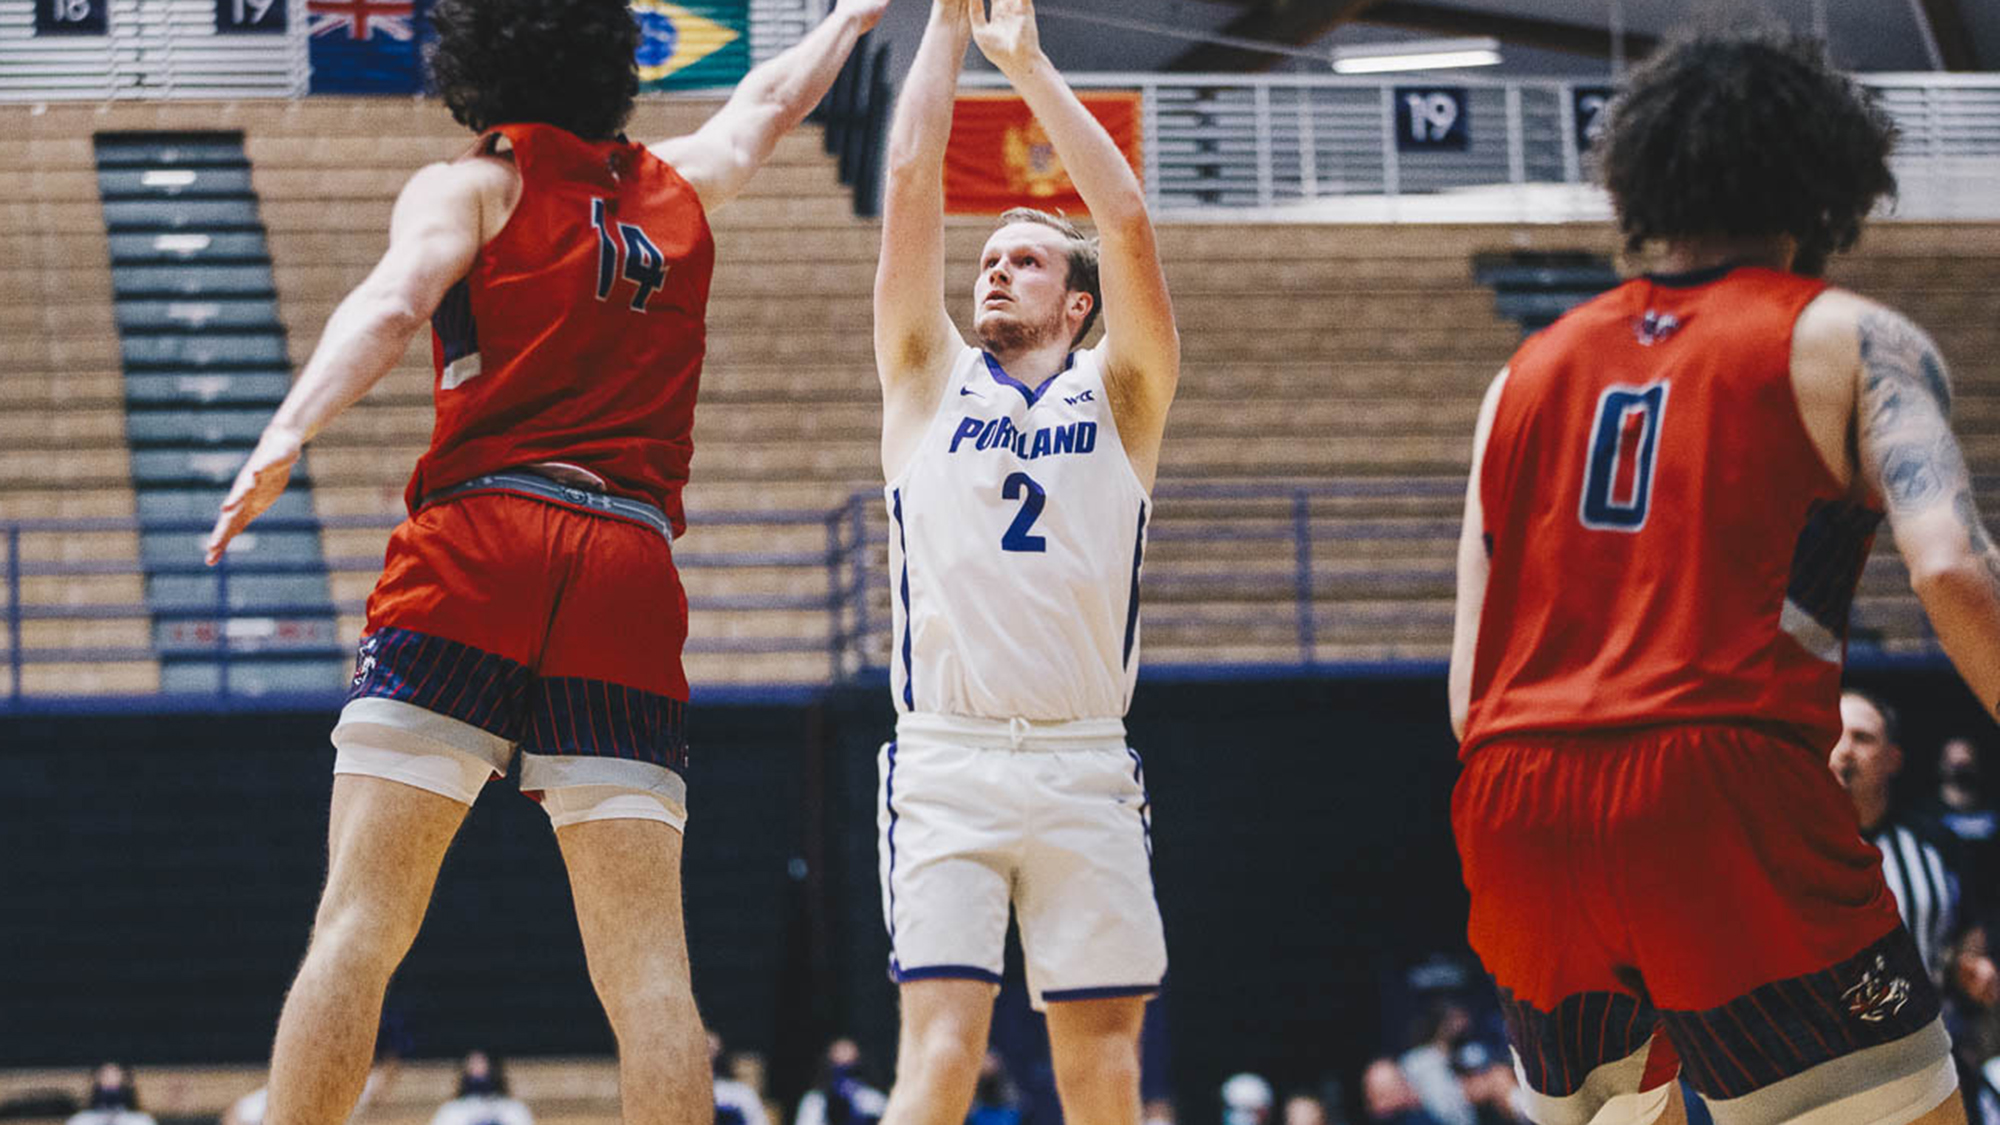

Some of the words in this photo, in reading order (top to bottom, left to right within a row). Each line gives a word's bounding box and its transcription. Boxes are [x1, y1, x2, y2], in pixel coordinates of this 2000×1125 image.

[1404, 92, 1458, 141] 19
[591, 197, 670, 314] 14
[948, 416, 1098, 460] PORTLAND
[1579, 379, 1671, 533] 0
[1001, 472, 1047, 552] 2
